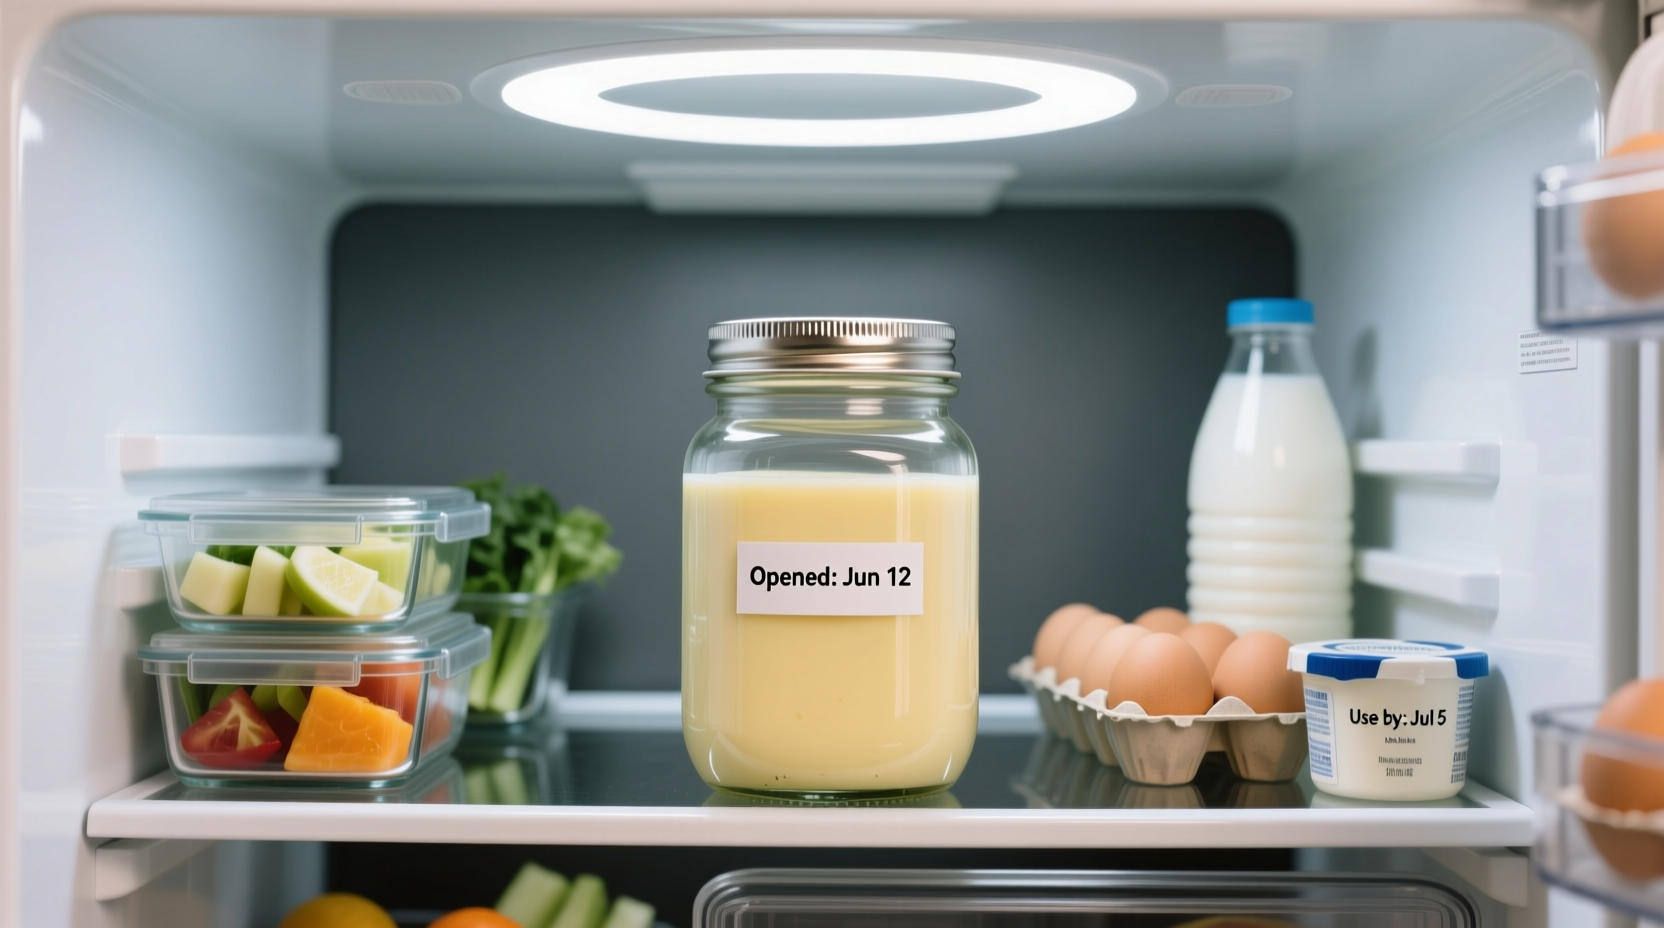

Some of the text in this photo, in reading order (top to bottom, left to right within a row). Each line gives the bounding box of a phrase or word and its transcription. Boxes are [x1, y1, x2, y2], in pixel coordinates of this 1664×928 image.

[750, 566, 911, 591] Opened: Jun 12
[1349, 708, 1447, 730] Use by: Jul 5
